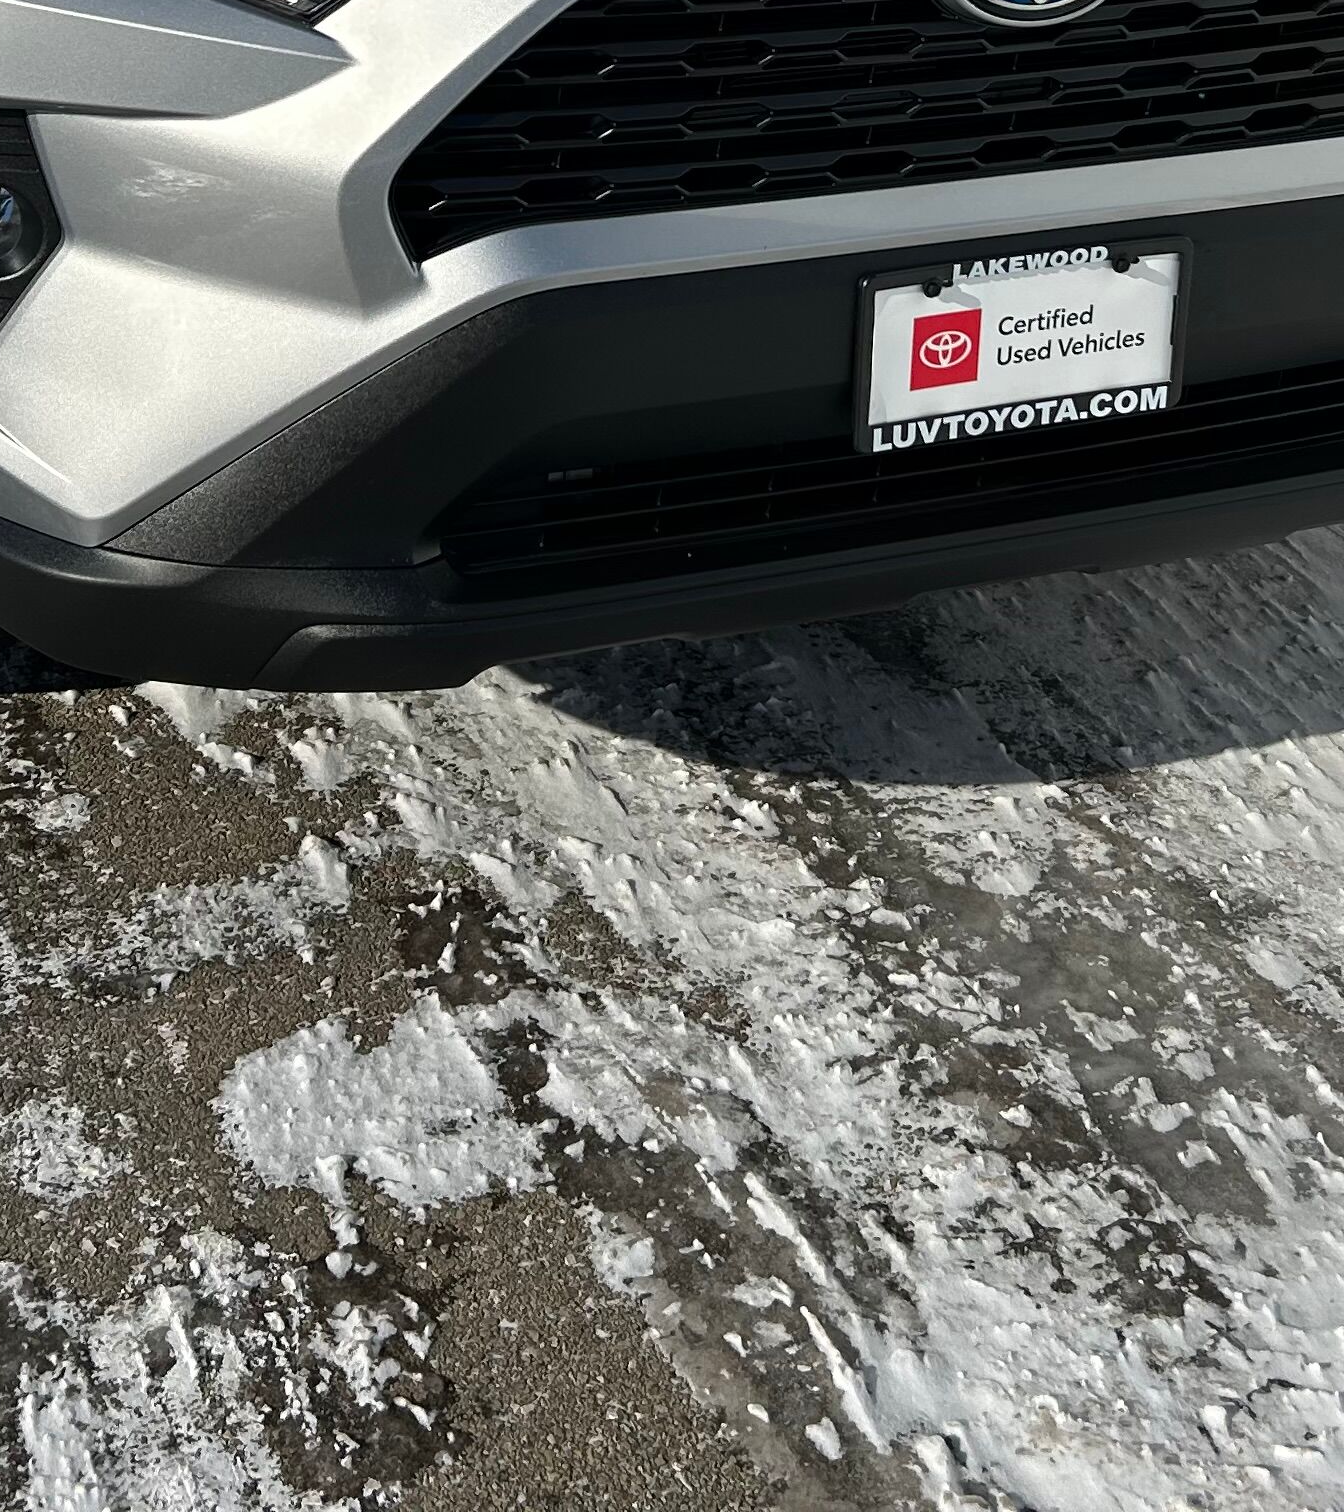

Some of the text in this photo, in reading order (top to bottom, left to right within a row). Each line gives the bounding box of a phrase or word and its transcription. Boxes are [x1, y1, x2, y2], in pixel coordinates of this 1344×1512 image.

[953, 246, 1109, 280] LAKEWOOD
[998, 304, 1094, 336] Certified
[996, 327, 1146, 366] Used Vehicles
[872, 385, 1169, 452] LUVTOYOTA.COM
